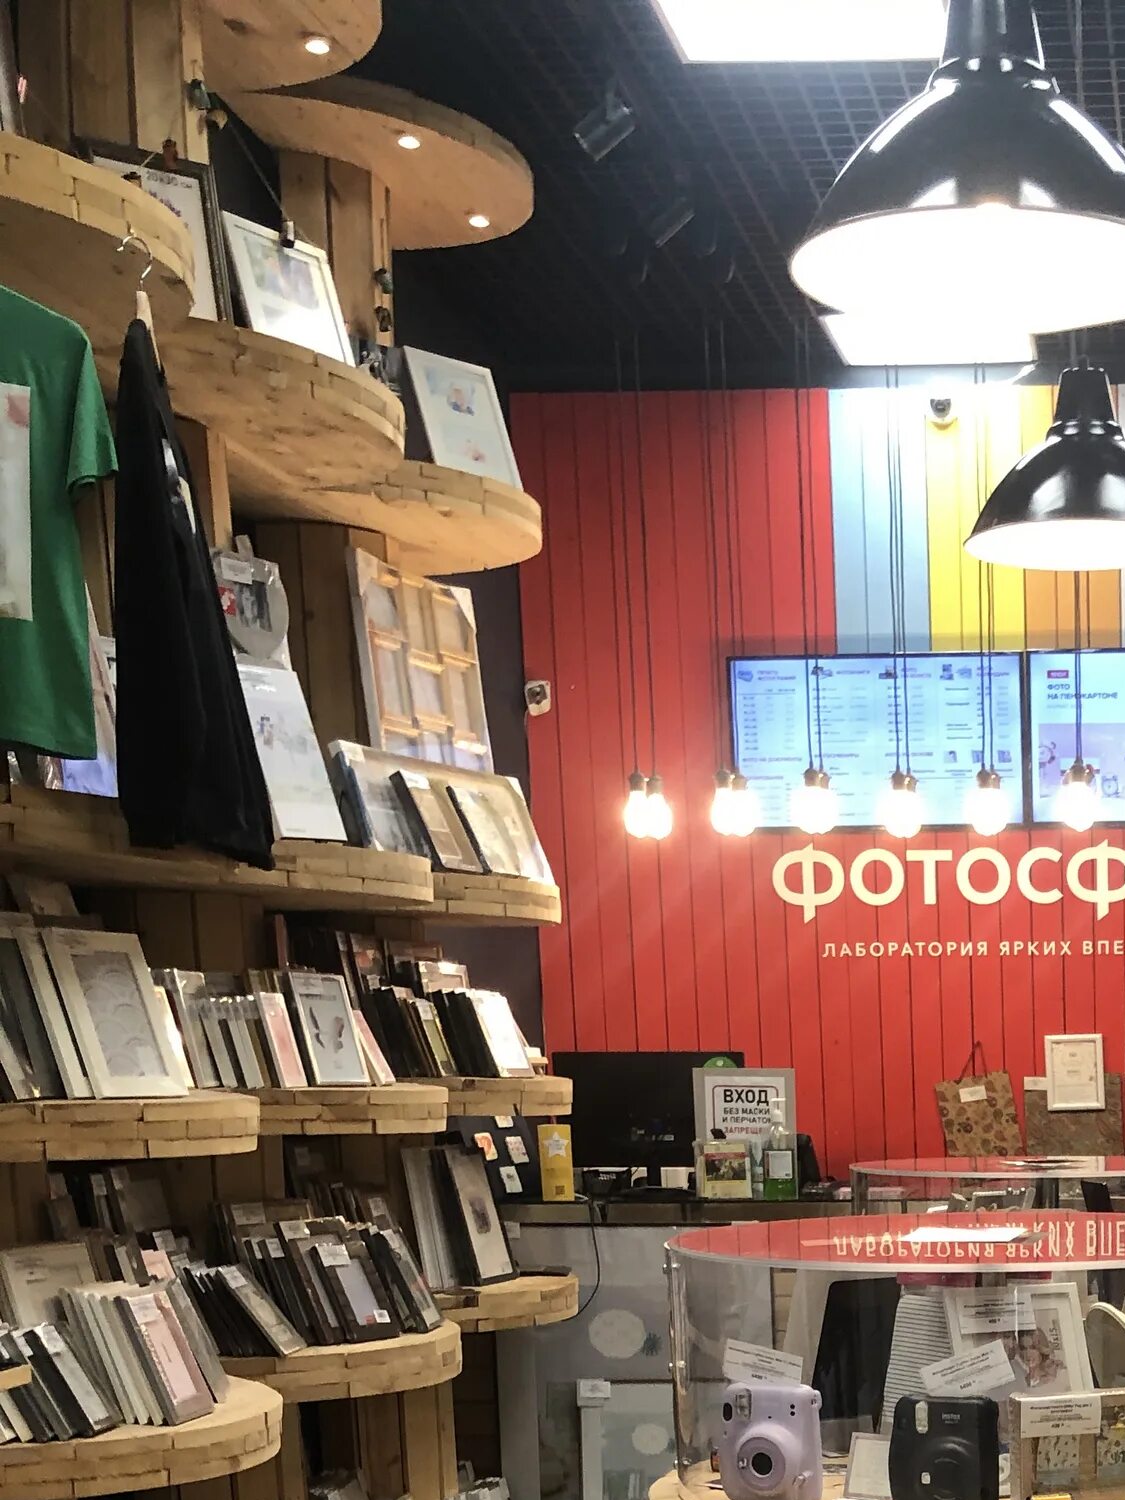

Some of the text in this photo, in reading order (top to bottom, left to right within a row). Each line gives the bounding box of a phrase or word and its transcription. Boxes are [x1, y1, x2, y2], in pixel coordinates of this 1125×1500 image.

[822, 940, 989, 958] ЛАБОРАТОРИЯ
[998, 938, 1073, 957] ЯРКИХ
[723, 1089, 769, 1106] ВХОД
[723, 1107, 770, 1115] БЕЗ МАСКИ
